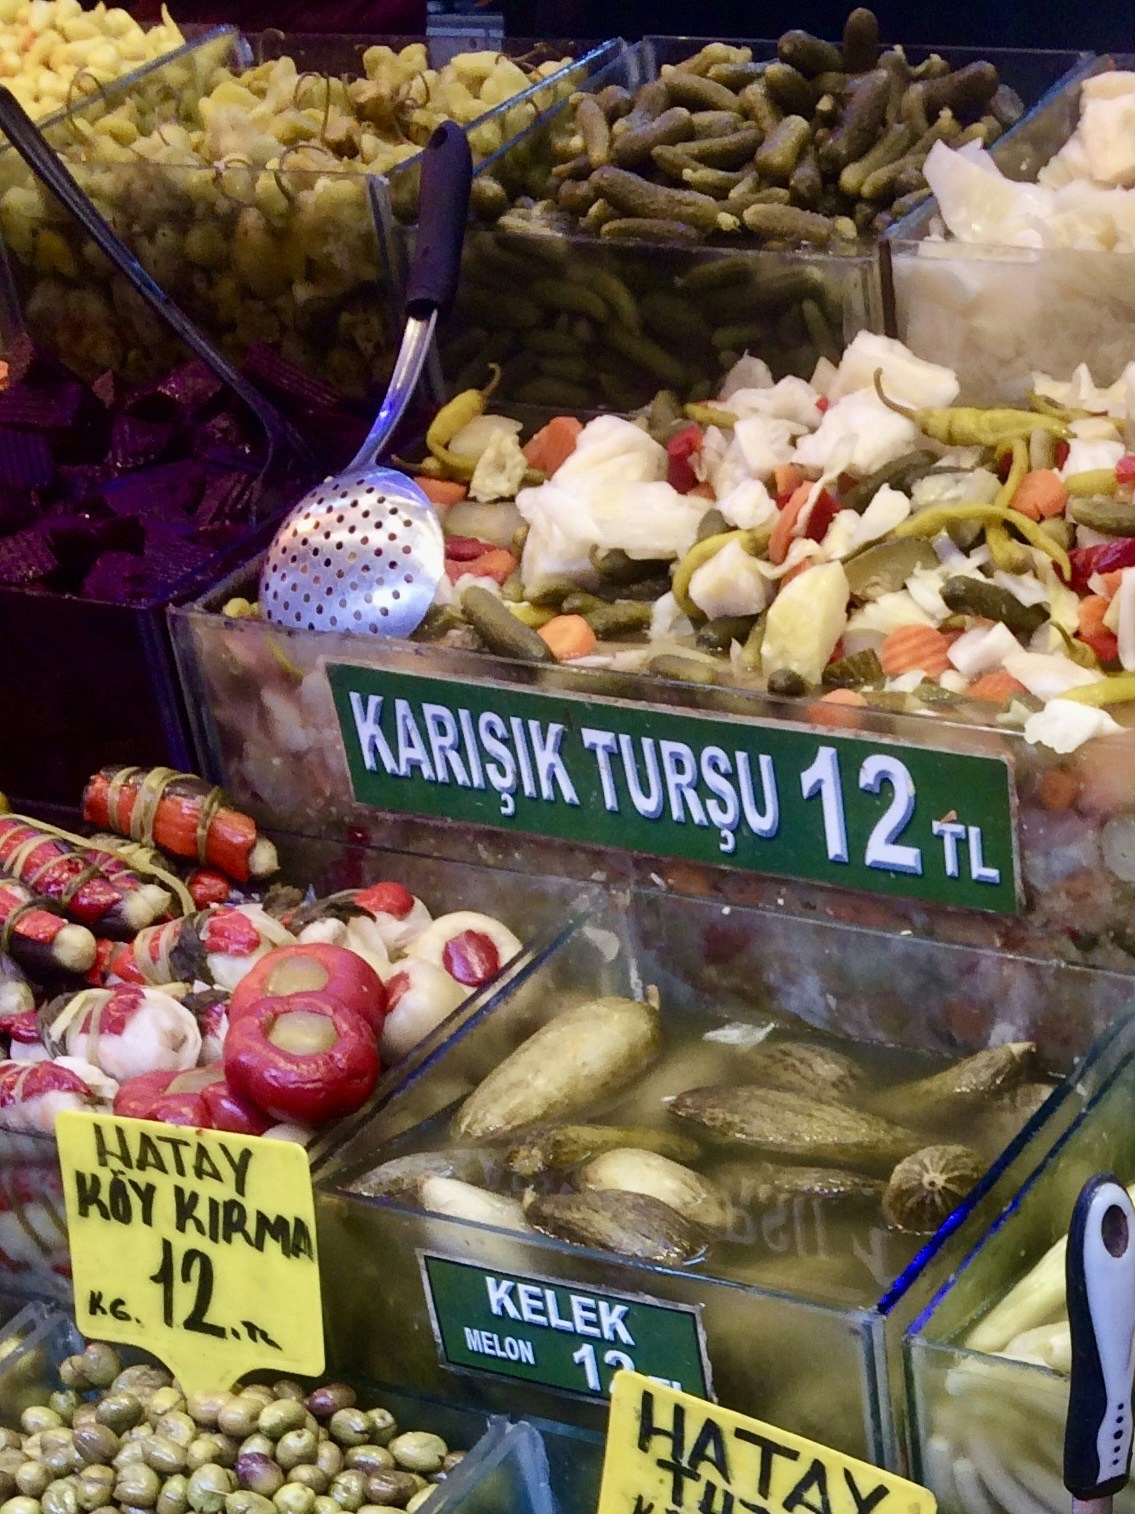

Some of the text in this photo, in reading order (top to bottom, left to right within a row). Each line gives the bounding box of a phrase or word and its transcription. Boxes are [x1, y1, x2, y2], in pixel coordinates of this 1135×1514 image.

[348, 690, 1001, 883] KARIŞIK TURŞU 12 TL
[93, 1122, 253, 1198] HATAY
[75, 1168, 315, 1262] KÖY KIRMA
[463, 1326, 537, 1365] MELON
[484, 1276, 636, 1346] KELEK
